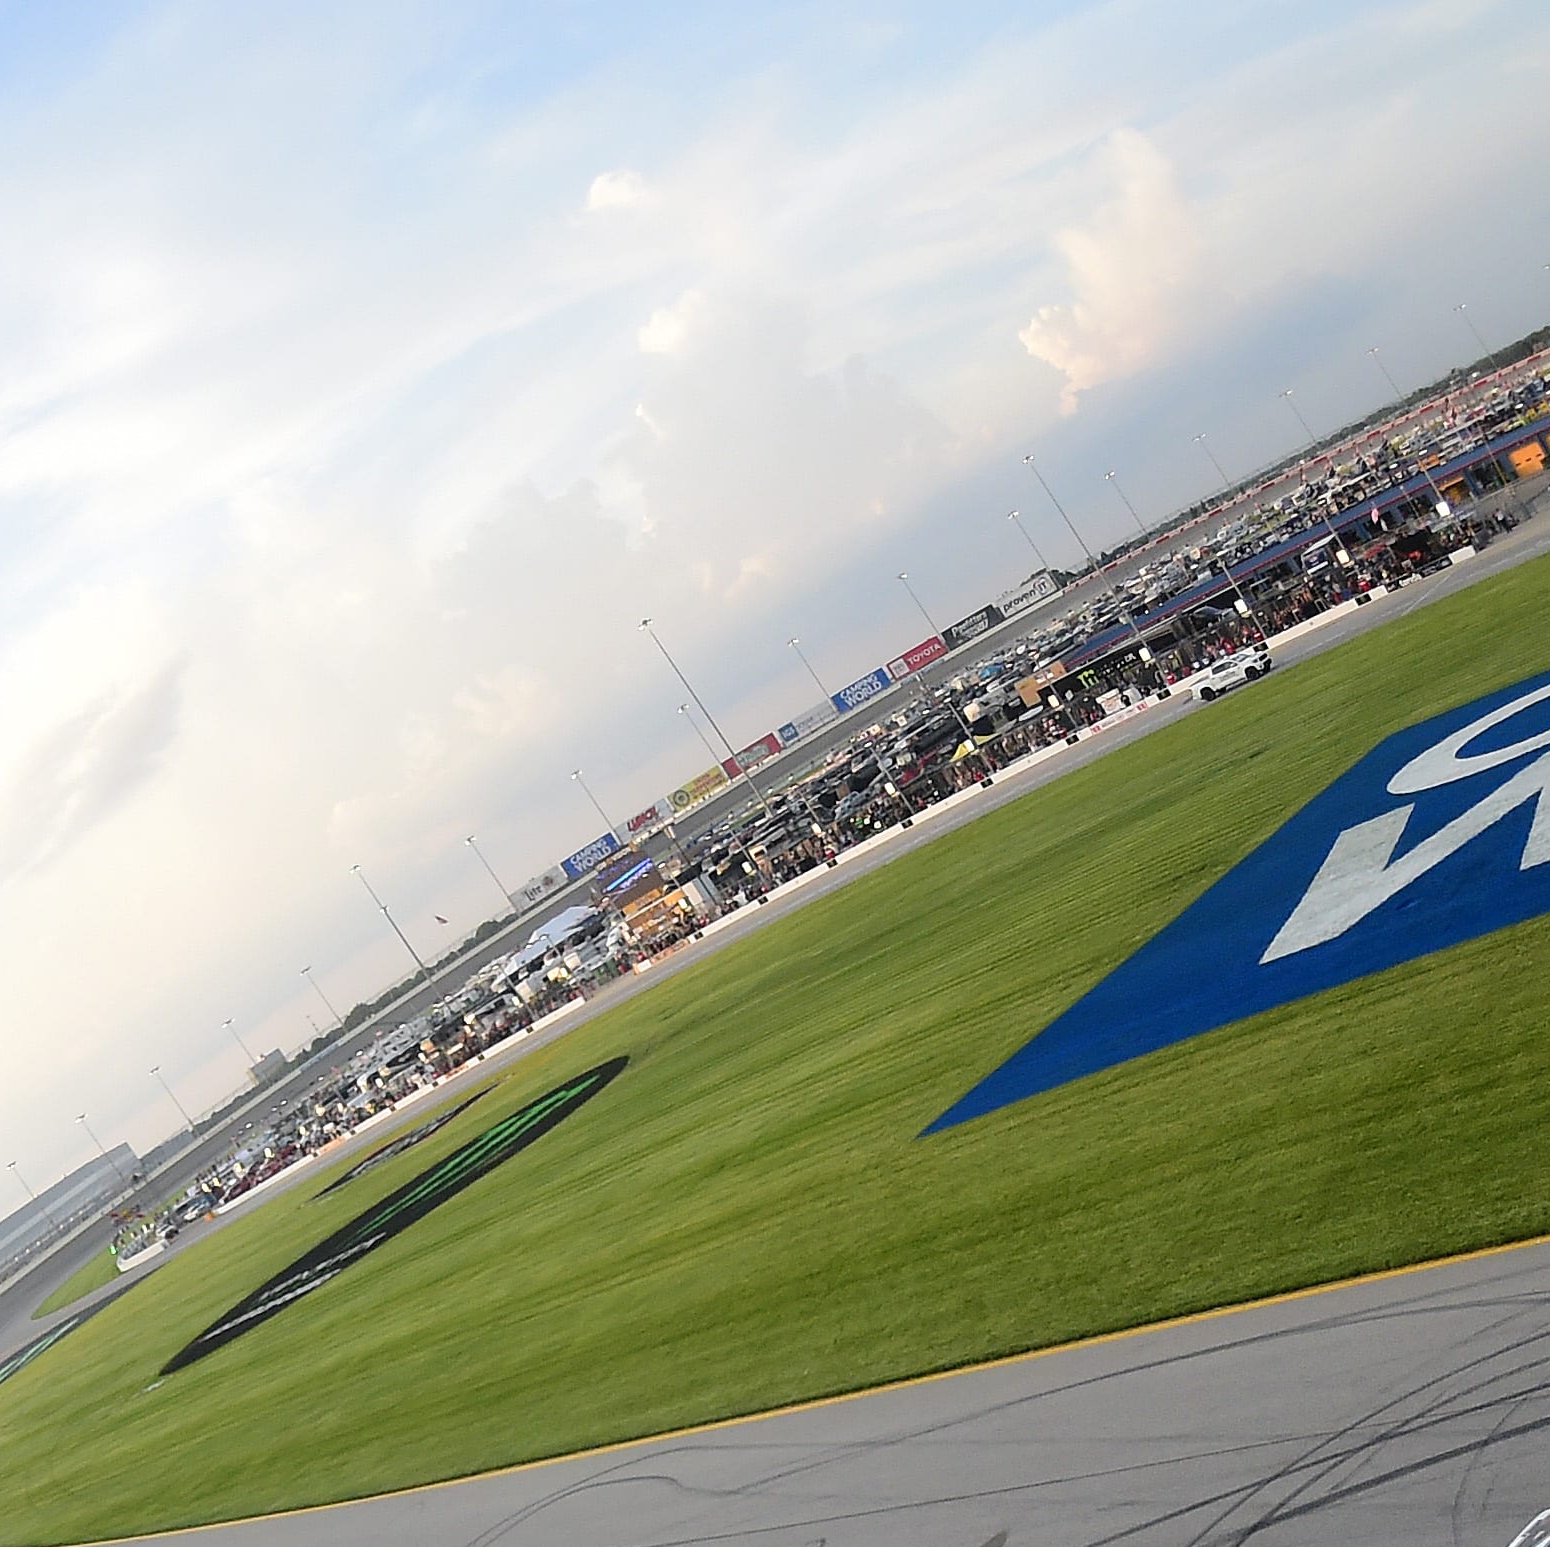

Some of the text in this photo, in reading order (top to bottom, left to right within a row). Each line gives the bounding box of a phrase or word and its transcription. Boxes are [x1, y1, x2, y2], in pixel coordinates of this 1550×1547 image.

[1003, 589, 1036, 613] proven
[907, 643, 941, 665] TOYOTA
[840, 672, 879, 699] CAMPING
[845, 681, 882, 707] WORLD
[570, 839, 608, 864] CAMPING
[573, 846, 612, 872] WORLD
